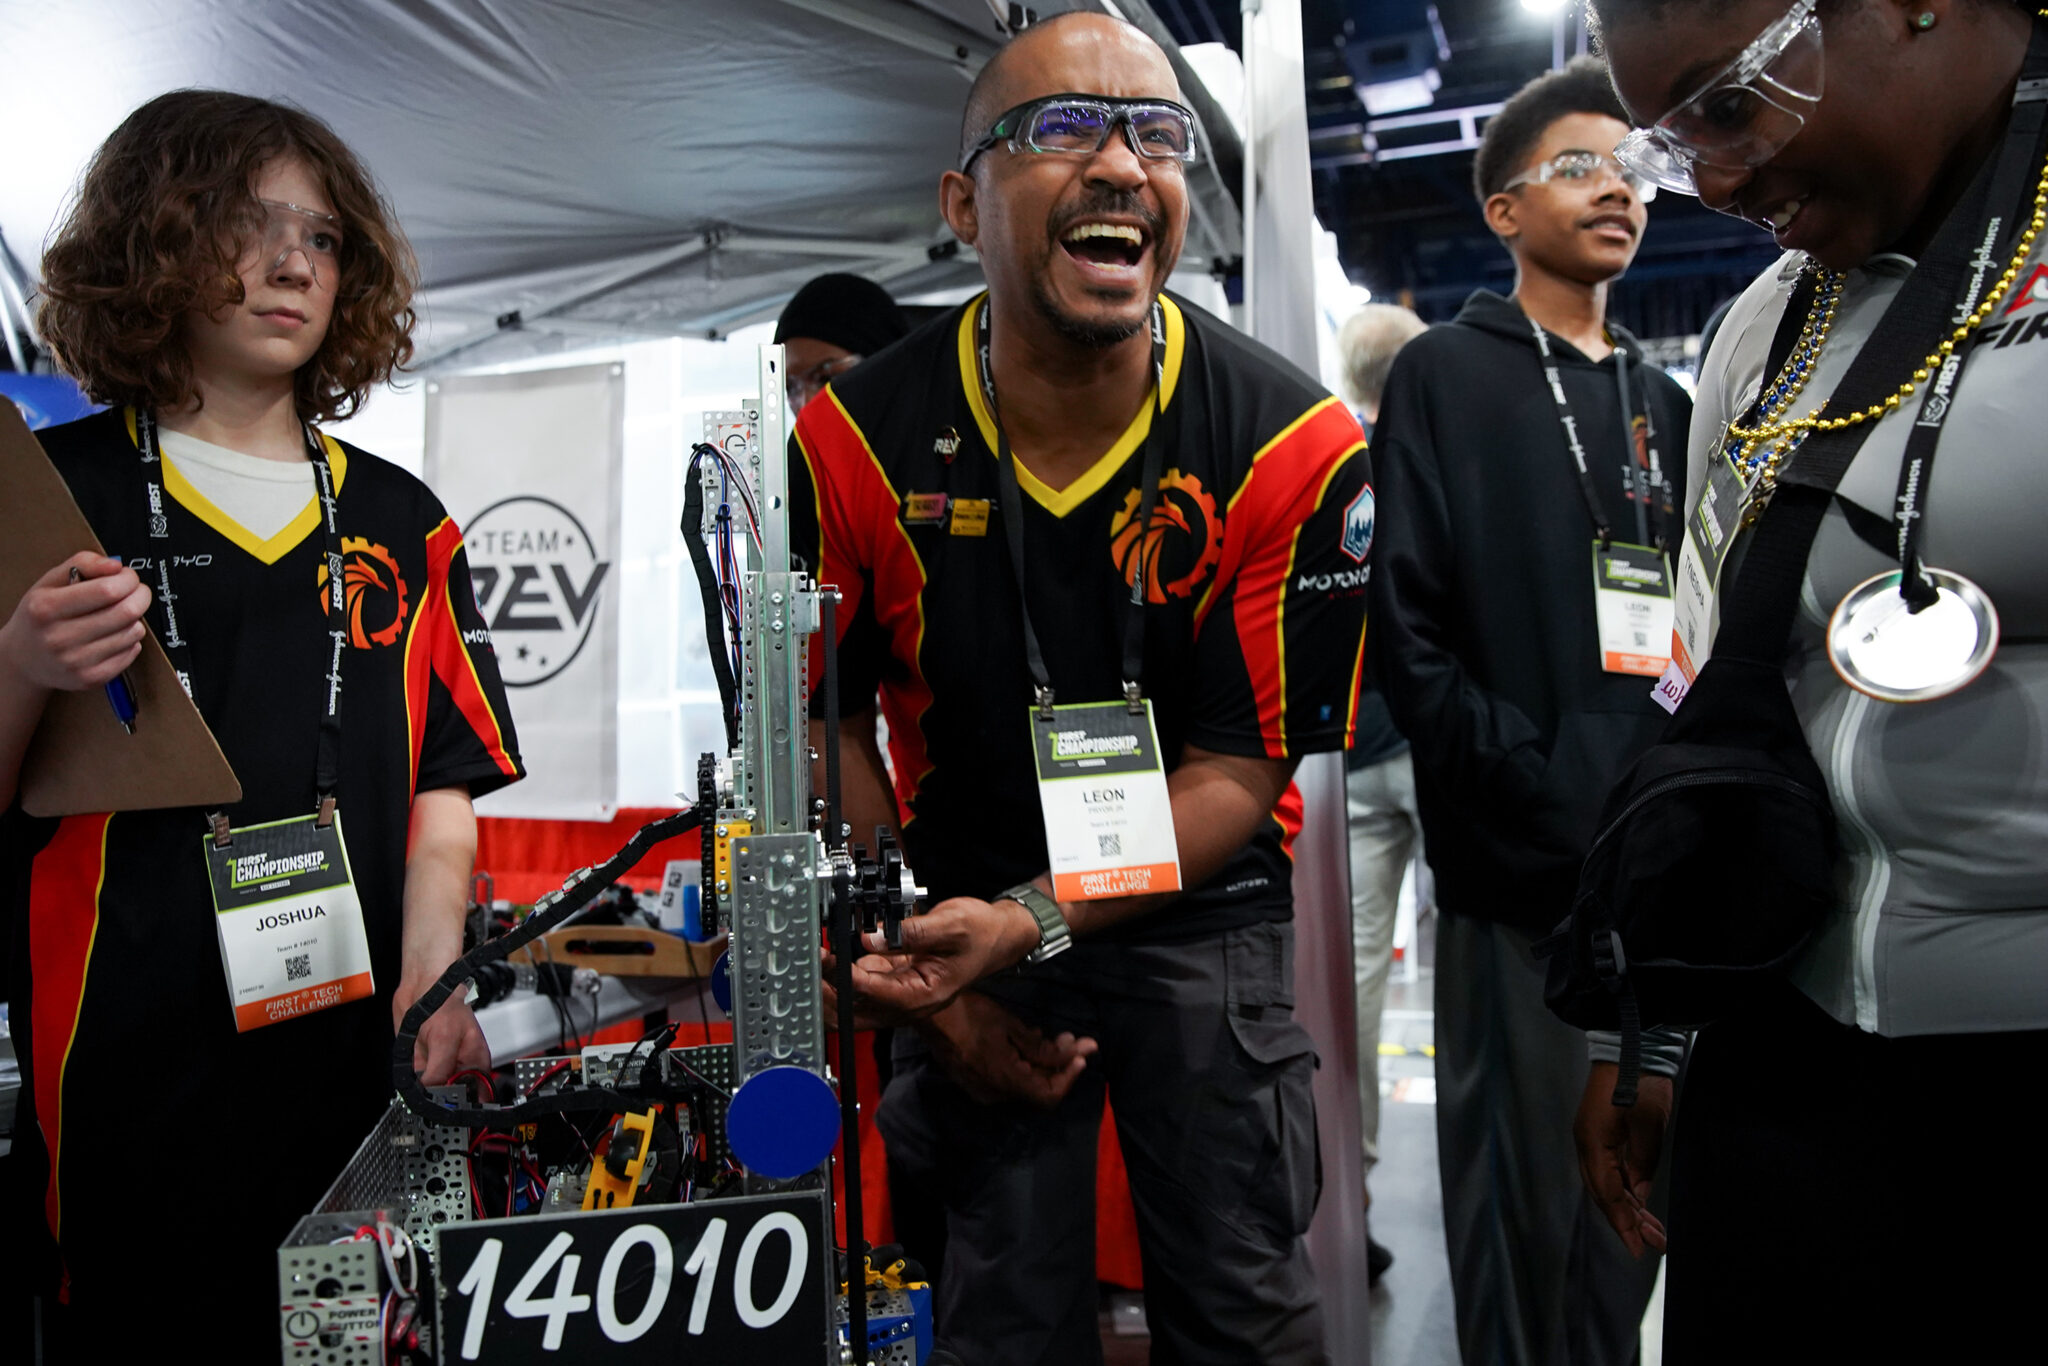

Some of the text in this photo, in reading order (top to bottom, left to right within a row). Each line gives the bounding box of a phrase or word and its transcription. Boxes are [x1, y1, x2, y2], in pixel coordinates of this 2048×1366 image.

[1934, 355, 1962, 394] FIRST
[148, 482, 163, 514] FIRST
[483, 529, 559, 555] TEAM
[332, 576, 344, 611] FIRST
[1083, 788, 1125, 804] LEON
[236, 850, 325, 882] CHAMPIONSHIP
[238, 852, 268, 868] FIRST
[1083, 880, 1150, 896] CHALLENGE
[1122, 869, 1152, 881] TECH
[256, 905, 327, 932] JOSHUA
[313, 984, 343, 1000] TECH
[269, 995, 341, 1021] CHALLENGE
[457, 1211, 809, 1361] 14010
[329, 1308, 377, 1319] POWER
